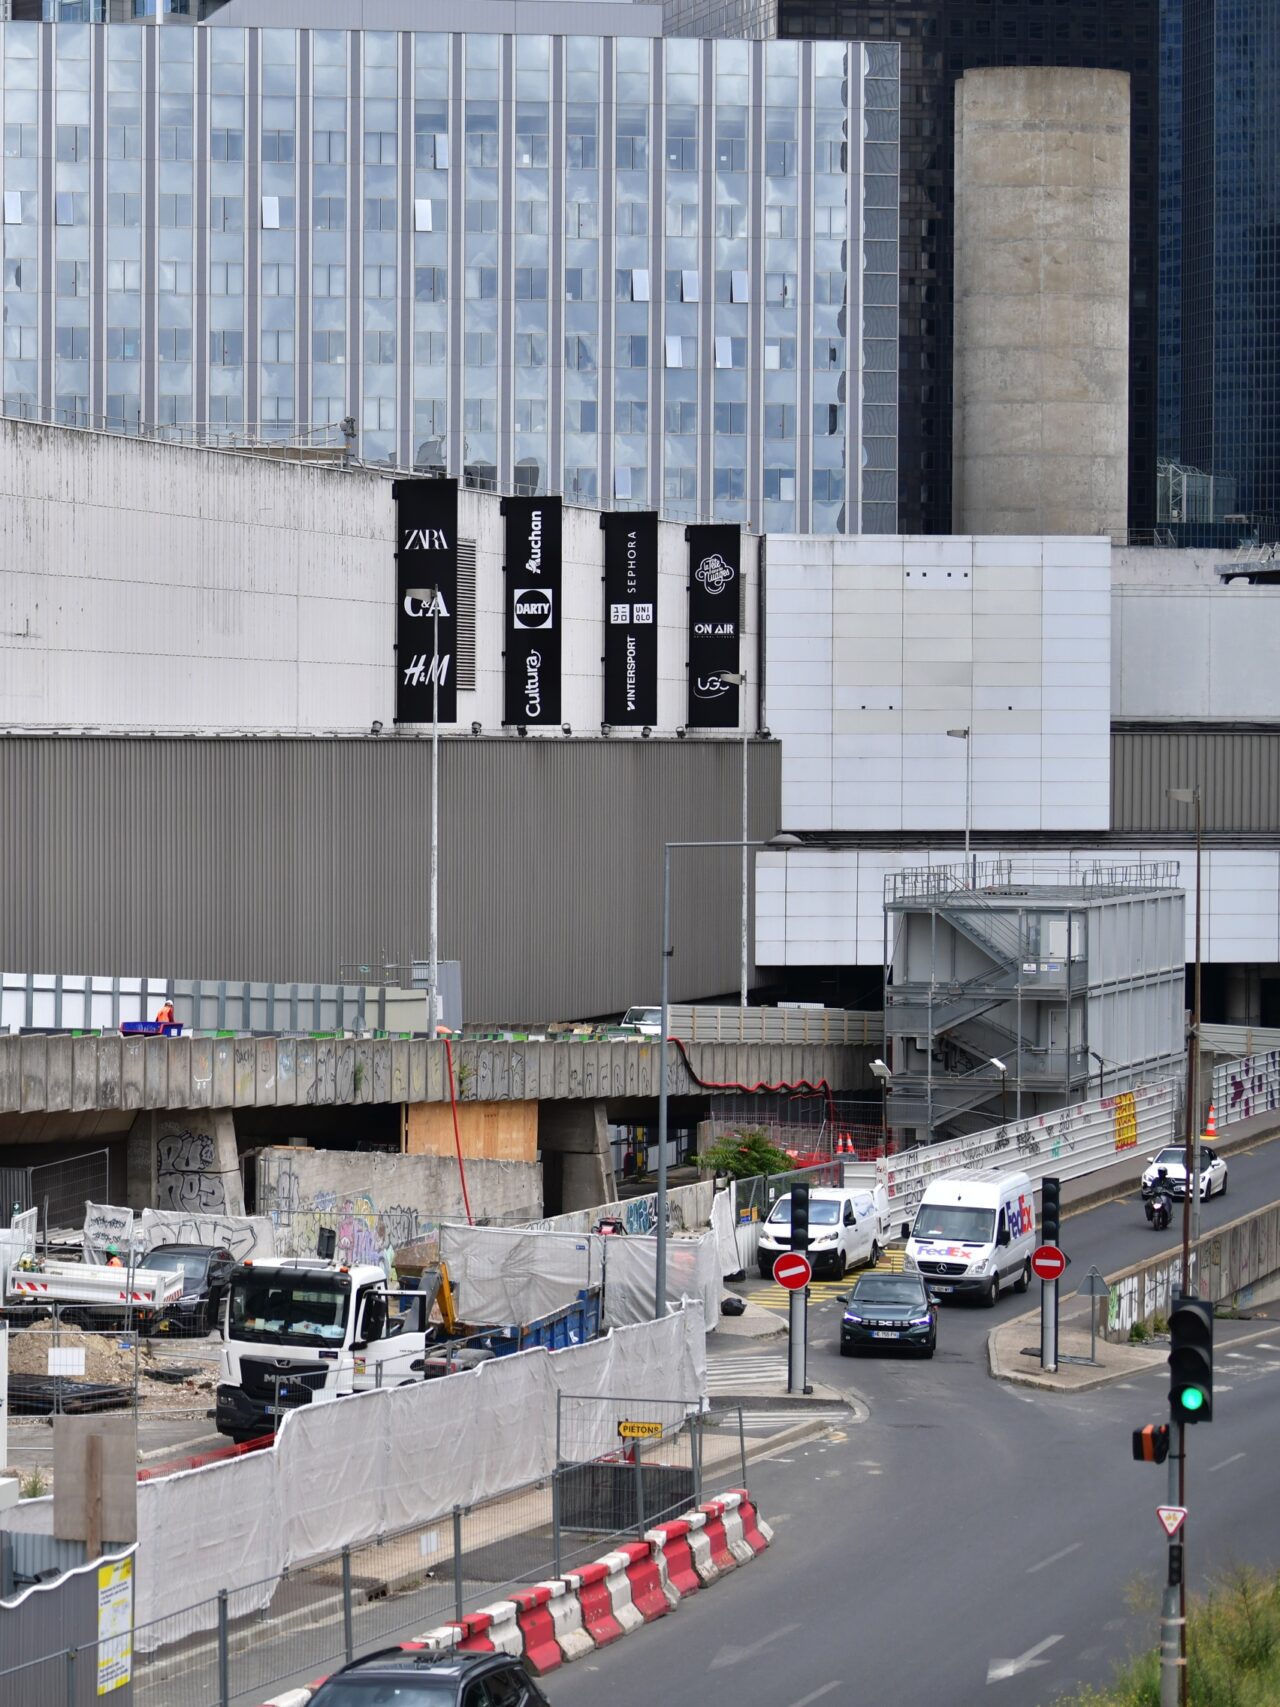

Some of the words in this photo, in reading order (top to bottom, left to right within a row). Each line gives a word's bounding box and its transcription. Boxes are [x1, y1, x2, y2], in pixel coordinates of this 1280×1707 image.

[404, 528, 449, 550] ZARA
[525, 510, 542, 574] Auchan
[627, 531, 637, 594] SEPHORA
[404, 591, 450, 617] C&A
[516, 603, 550, 615] DARTY
[694, 623, 712, 634] ON
[714, 623, 734, 634] AIR
[404, 654, 450, 687] H&M
[626, 635, 636, 701] INTERSPORT
[525, 648, 542, 718] Cultura
[1005, 1193, 1033, 1240] FedEx
[916, 1246, 973, 1259] FedEx
[263, 1374, 302, 1385] MAN
